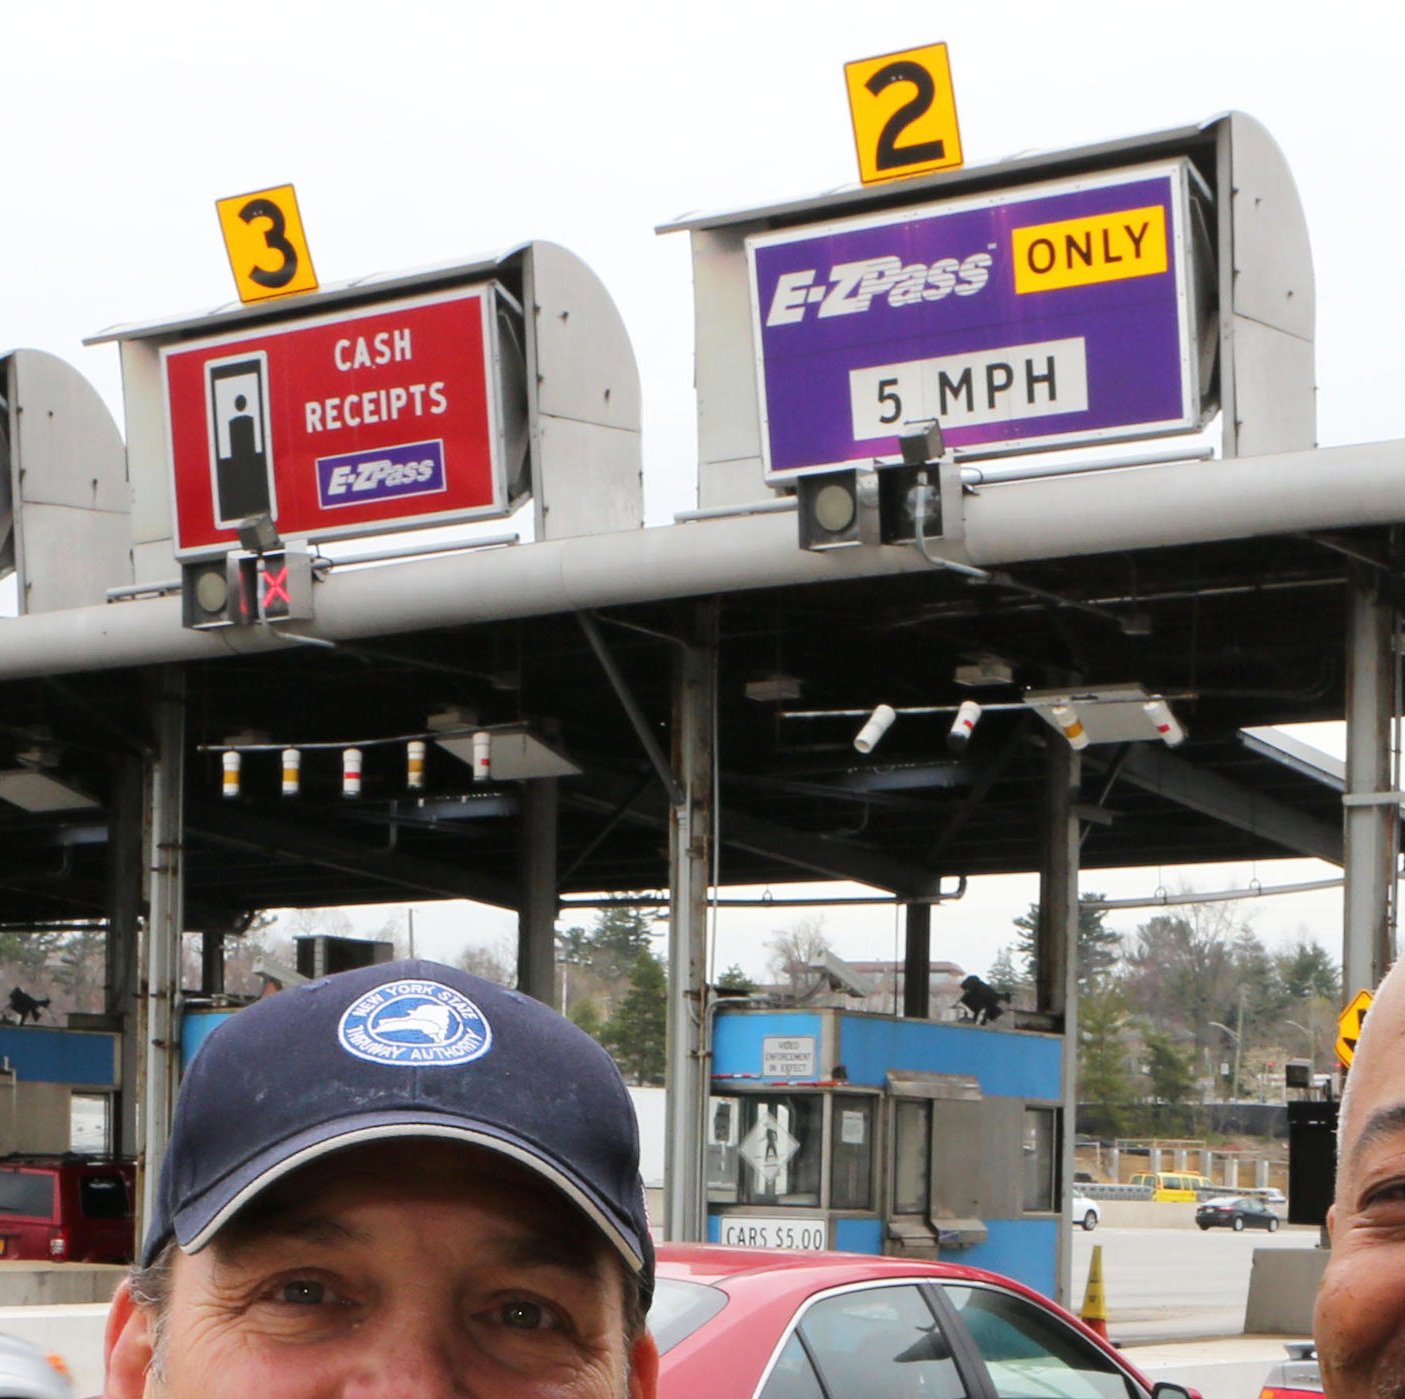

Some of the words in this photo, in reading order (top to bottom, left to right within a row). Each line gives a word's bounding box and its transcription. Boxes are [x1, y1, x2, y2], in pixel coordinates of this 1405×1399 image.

[864, 60, 946, 173] 2
[238, 198, 298, 288] 3
[1026, 221, 1150, 276] ONLY
[766, 252, 993, 327] E-ZPass
[333, 328, 413, 372] CASH
[304, 381, 448, 433] RECEIPTS
[876, 378, 903, 425] 5
[938, 355, 1058, 417] MPH
[327, 457, 435, 496] E-ZPass
[352, 992, 384, 1017] NEW
[386, 984, 434, 996] YORK
[437, 990, 480, 1021] STATE
[346, 1024, 407, 1059] THRUWAY
[410, 1027, 484, 1060] AUTHORITY
[726, 1226, 768, 1248] CARS
[775, 1226, 824, 1250] $5.00
